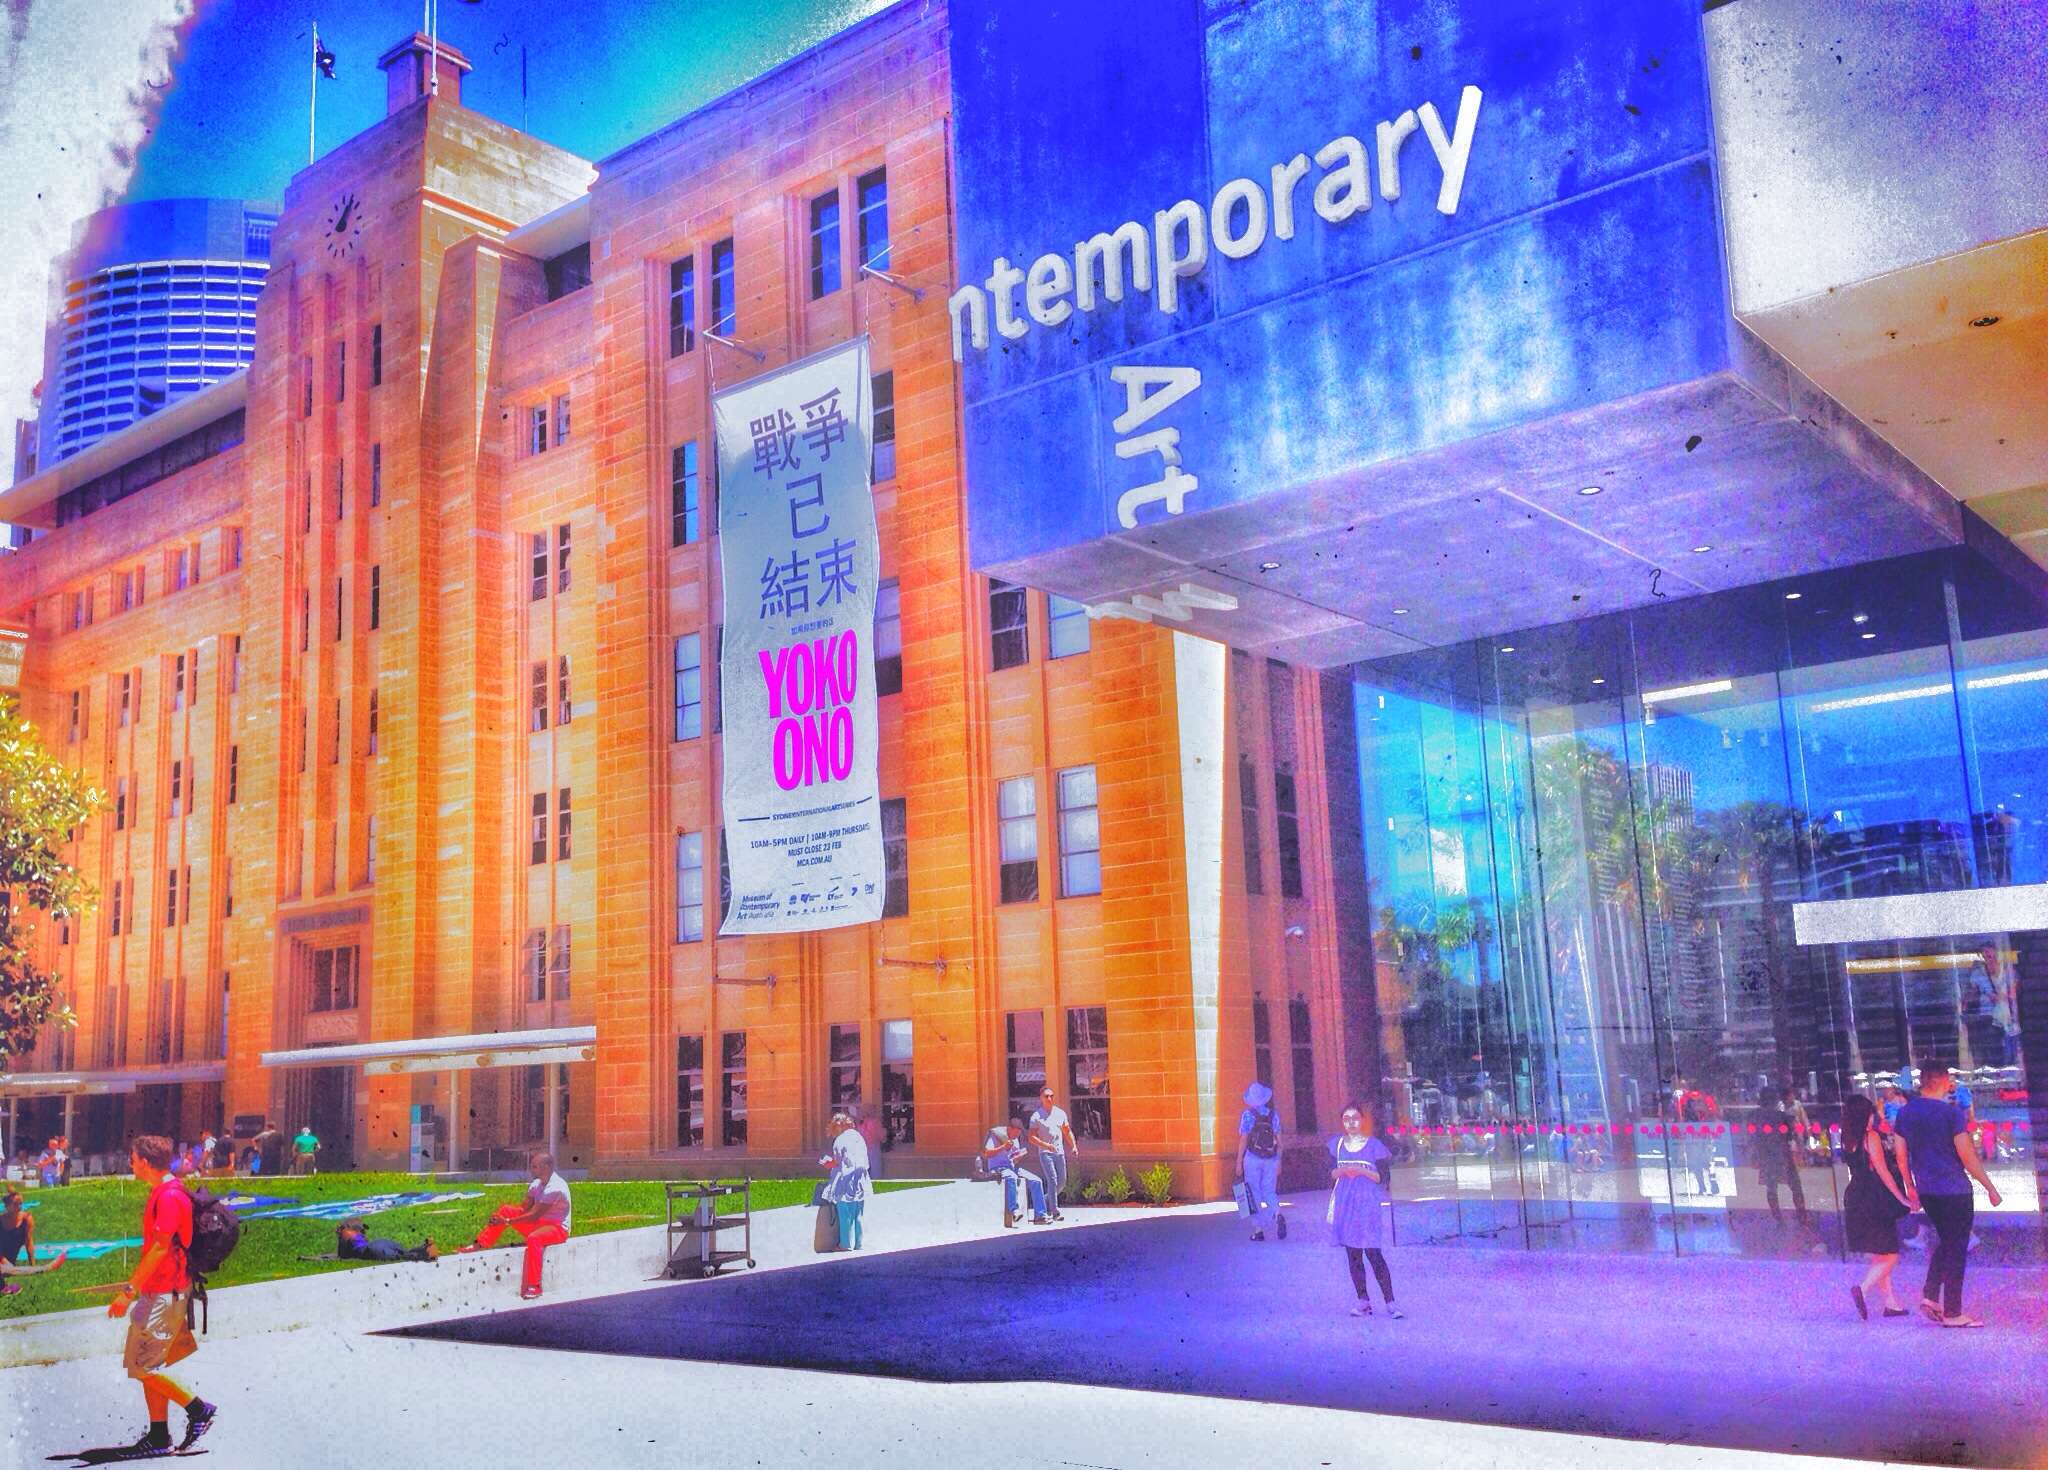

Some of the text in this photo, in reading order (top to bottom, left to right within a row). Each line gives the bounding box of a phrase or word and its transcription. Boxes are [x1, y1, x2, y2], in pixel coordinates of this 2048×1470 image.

[749, 387, 849, 480] 戰爭
[1110, 365, 1201, 529] Art
[759, 537, 858, 620] 結束
[758, 629, 858, 718] YOKO
[773, 706, 854, 791] ONO
[789, 835, 805, 845] DAILY
[788, 847, 804, 857] MUST
[804, 845, 823, 855] CLOSE
[832, 841, 842, 850] FEB
[796, 854, 833, 867] MCA.COM.AU
[740, 901, 781, 911] Contemporary
[742, 895, 766, 903] Museum
[736, 911, 748, 920] Art
